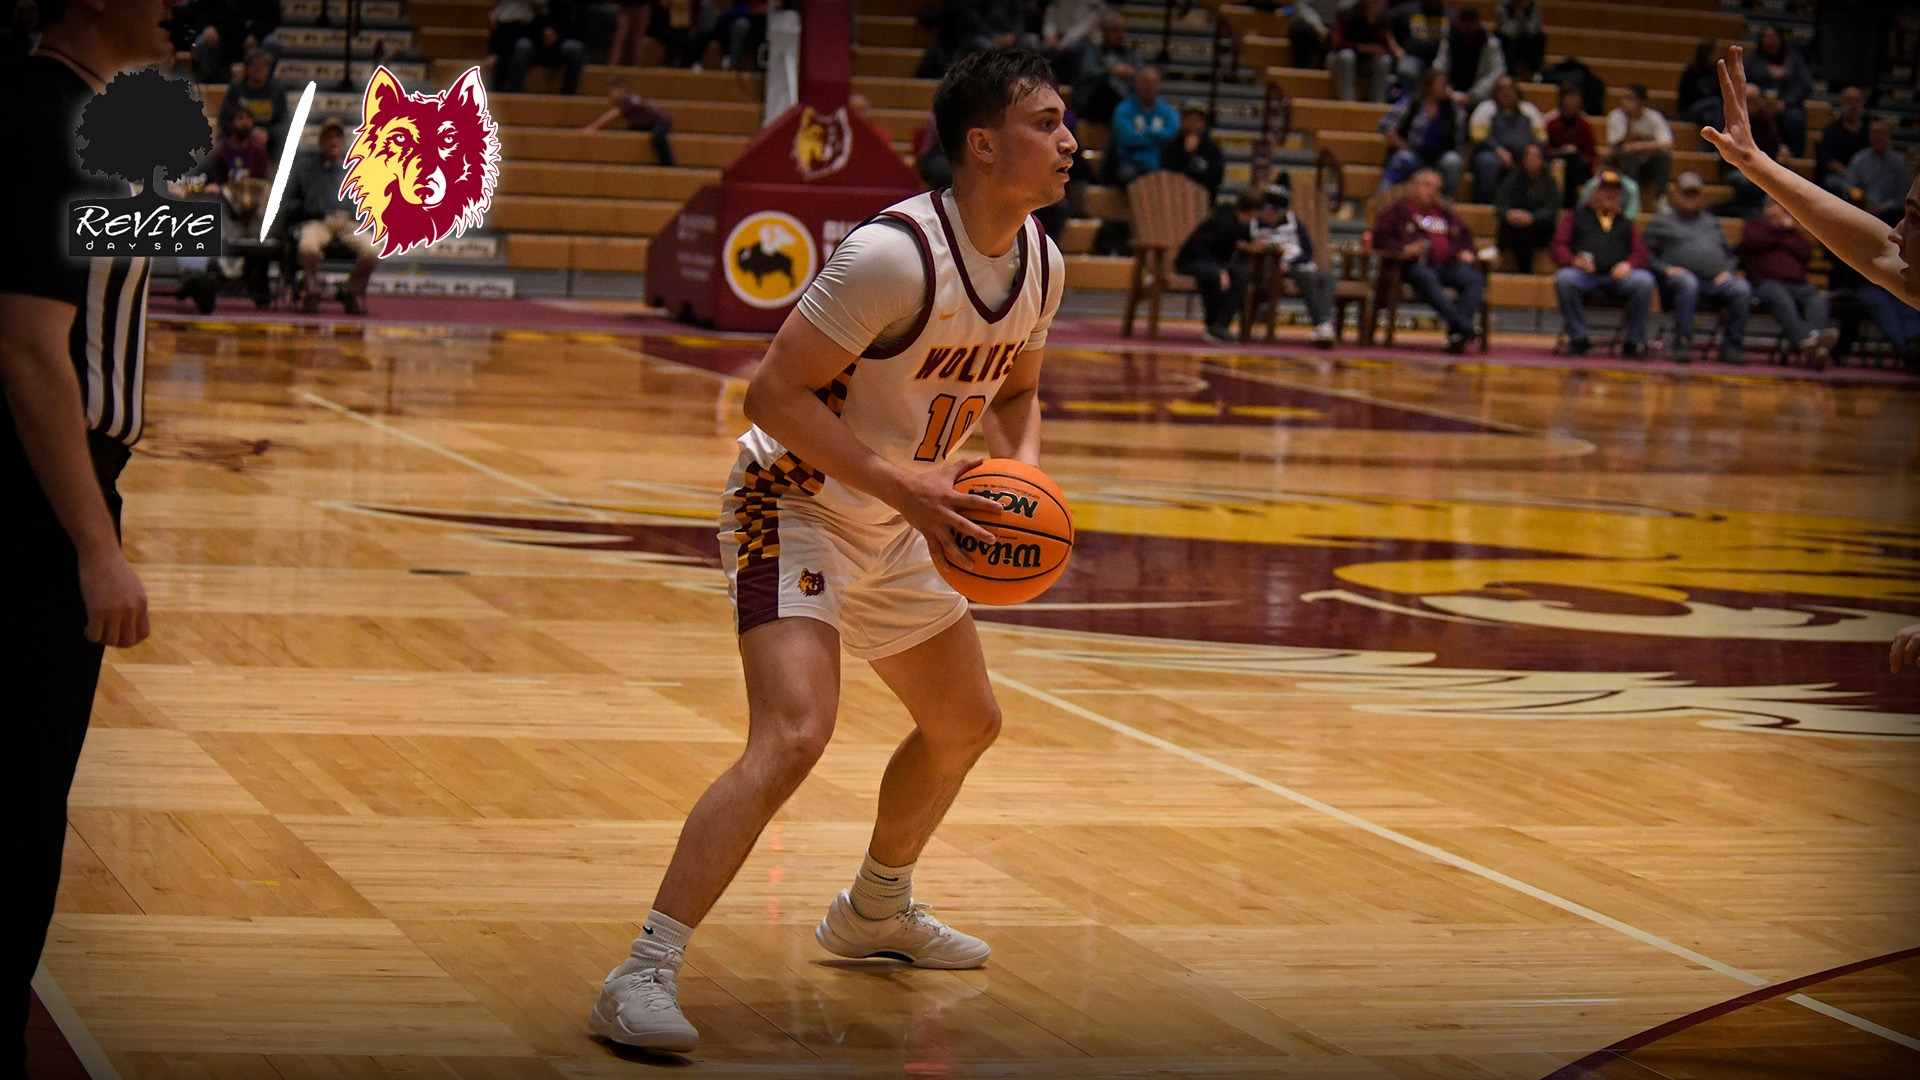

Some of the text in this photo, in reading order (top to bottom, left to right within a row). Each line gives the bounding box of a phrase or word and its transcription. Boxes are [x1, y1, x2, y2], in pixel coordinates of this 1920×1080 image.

[913, 339, 1026, 384] WOLVES
[914, 393, 986, 462] 10
[949, 525, 1042, 568] Wilson
